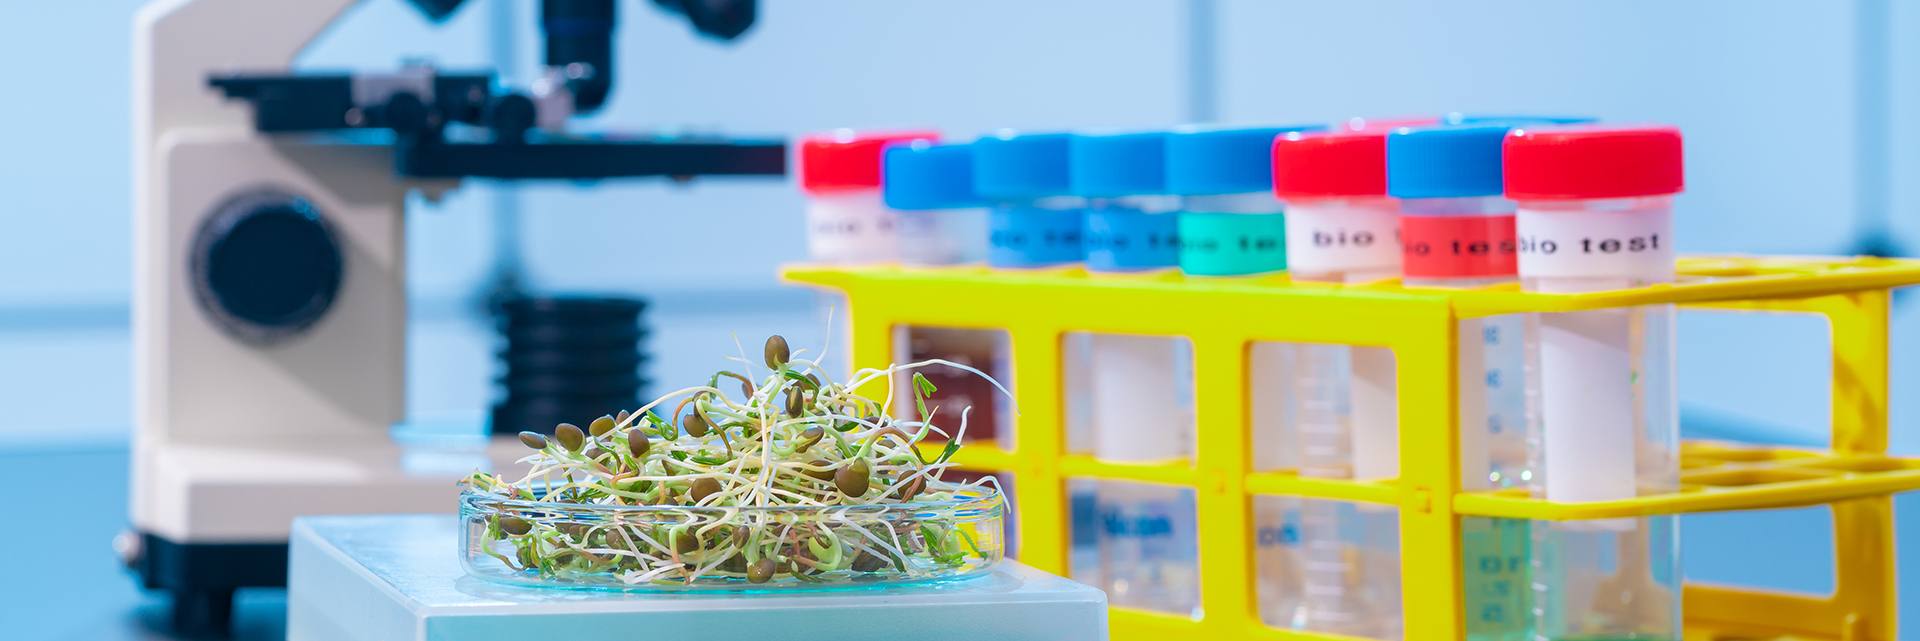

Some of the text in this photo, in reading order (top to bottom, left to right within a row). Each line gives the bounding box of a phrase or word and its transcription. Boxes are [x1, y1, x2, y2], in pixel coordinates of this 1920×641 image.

[1313, 230, 1374, 248] bio
[1451, 239, 1516, 256] tes
[1580, 231, 1659, 254] test
